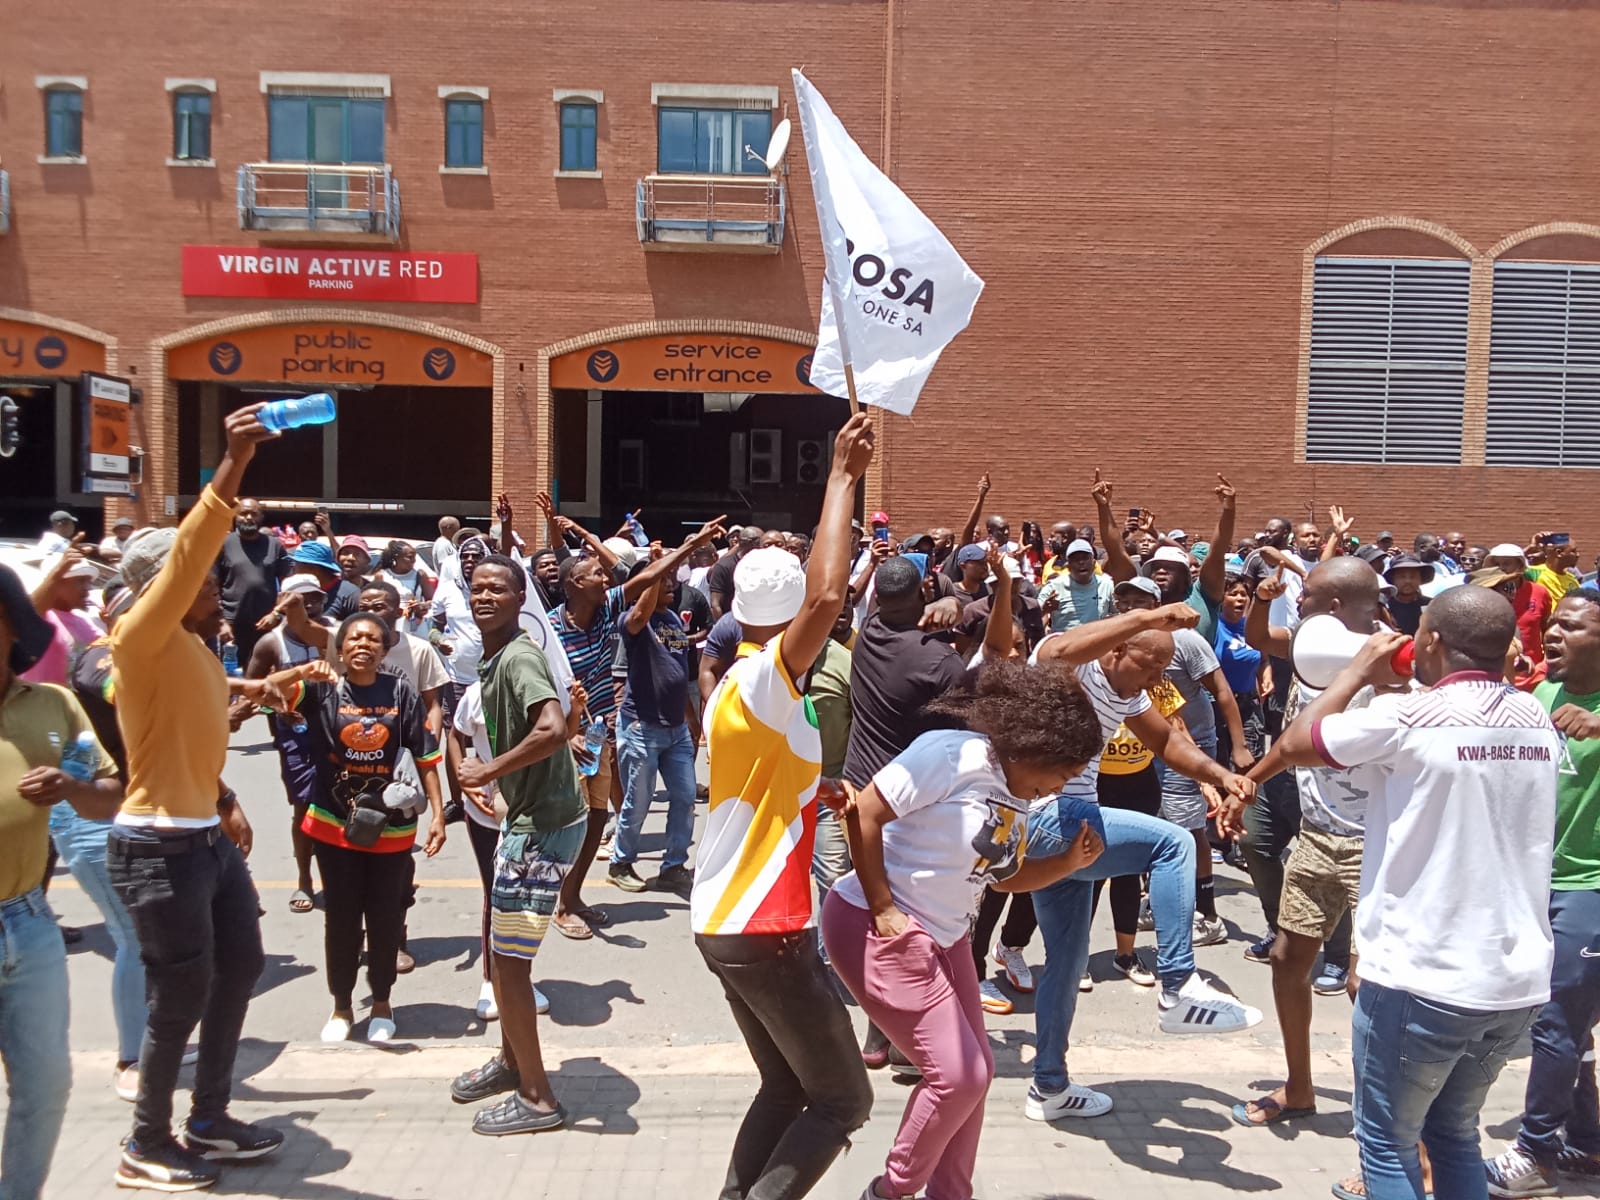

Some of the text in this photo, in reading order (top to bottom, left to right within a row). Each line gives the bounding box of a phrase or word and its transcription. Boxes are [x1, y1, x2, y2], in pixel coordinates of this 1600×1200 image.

[218, 254, 443, 279] VIRGIN ACTIVE RED
[308, 279, 354, 290] PARKING
[862, 300, 923, 337] ONE SA
[294, 329, 372, 354] public
[664, 342, 762, 360] service
[282, 353, 385, 381] parking
[653, 362, 772, 383] entrance
[345, 747, 384, 761] SANCO
[1107, 741, 1148, 756] BOSA
[1457, 745, 1551, 762] KWA-BASE ROMA
